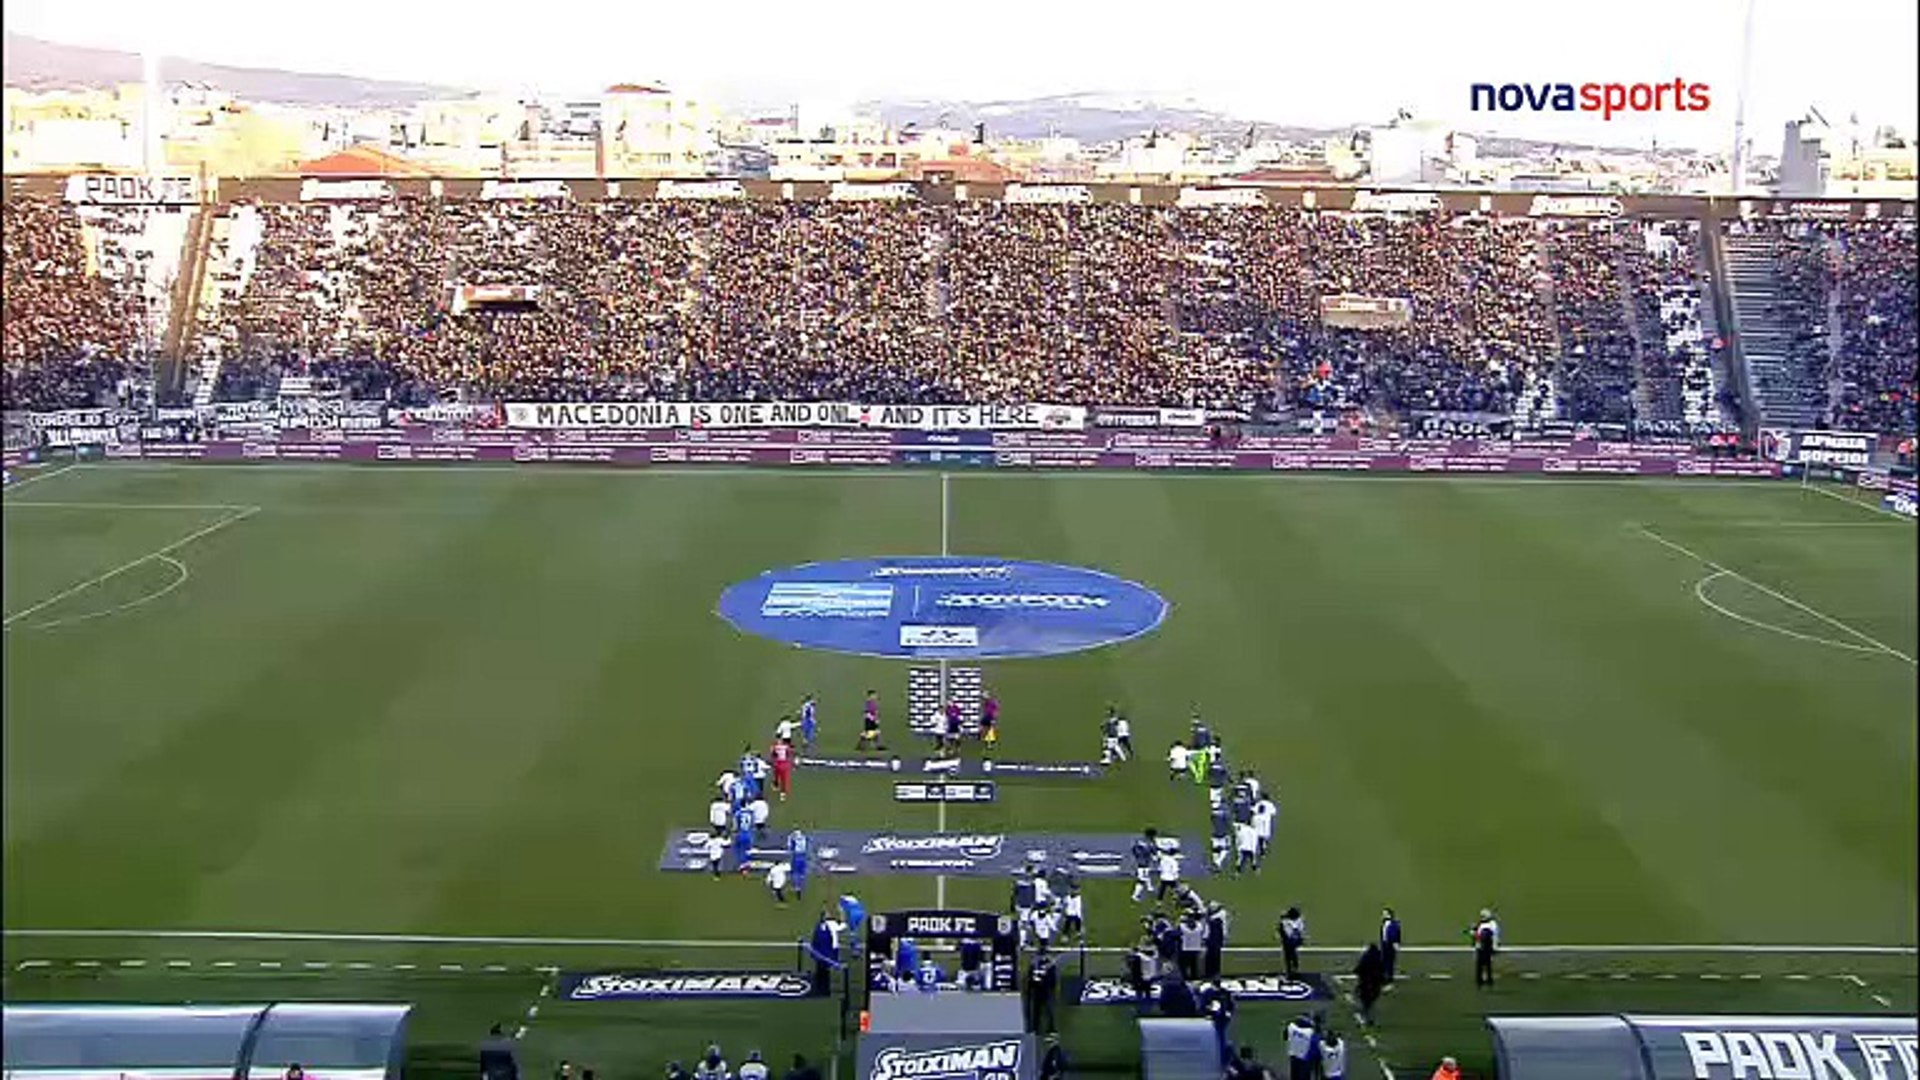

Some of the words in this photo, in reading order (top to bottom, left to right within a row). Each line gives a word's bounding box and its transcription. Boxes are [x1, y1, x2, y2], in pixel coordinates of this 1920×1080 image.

[537, 404, 679, 424] MACEDONIA
[690, 404, 712, 424] IS
[720, 404, 763, 424] ONE
[770, 404, 812, 423] AND
[880, 406, 923, 425] AND
[932, 406, 971, 425] IT'S
[980, 405, 1038, 426] HERE
[907, 917, 951, 932] PAOK
[954, 917, 977, 932] FC
[879, 1044, 1017, 1078] STOIXIMAN
[1681, 1032, 1857, 1080] PAOK
